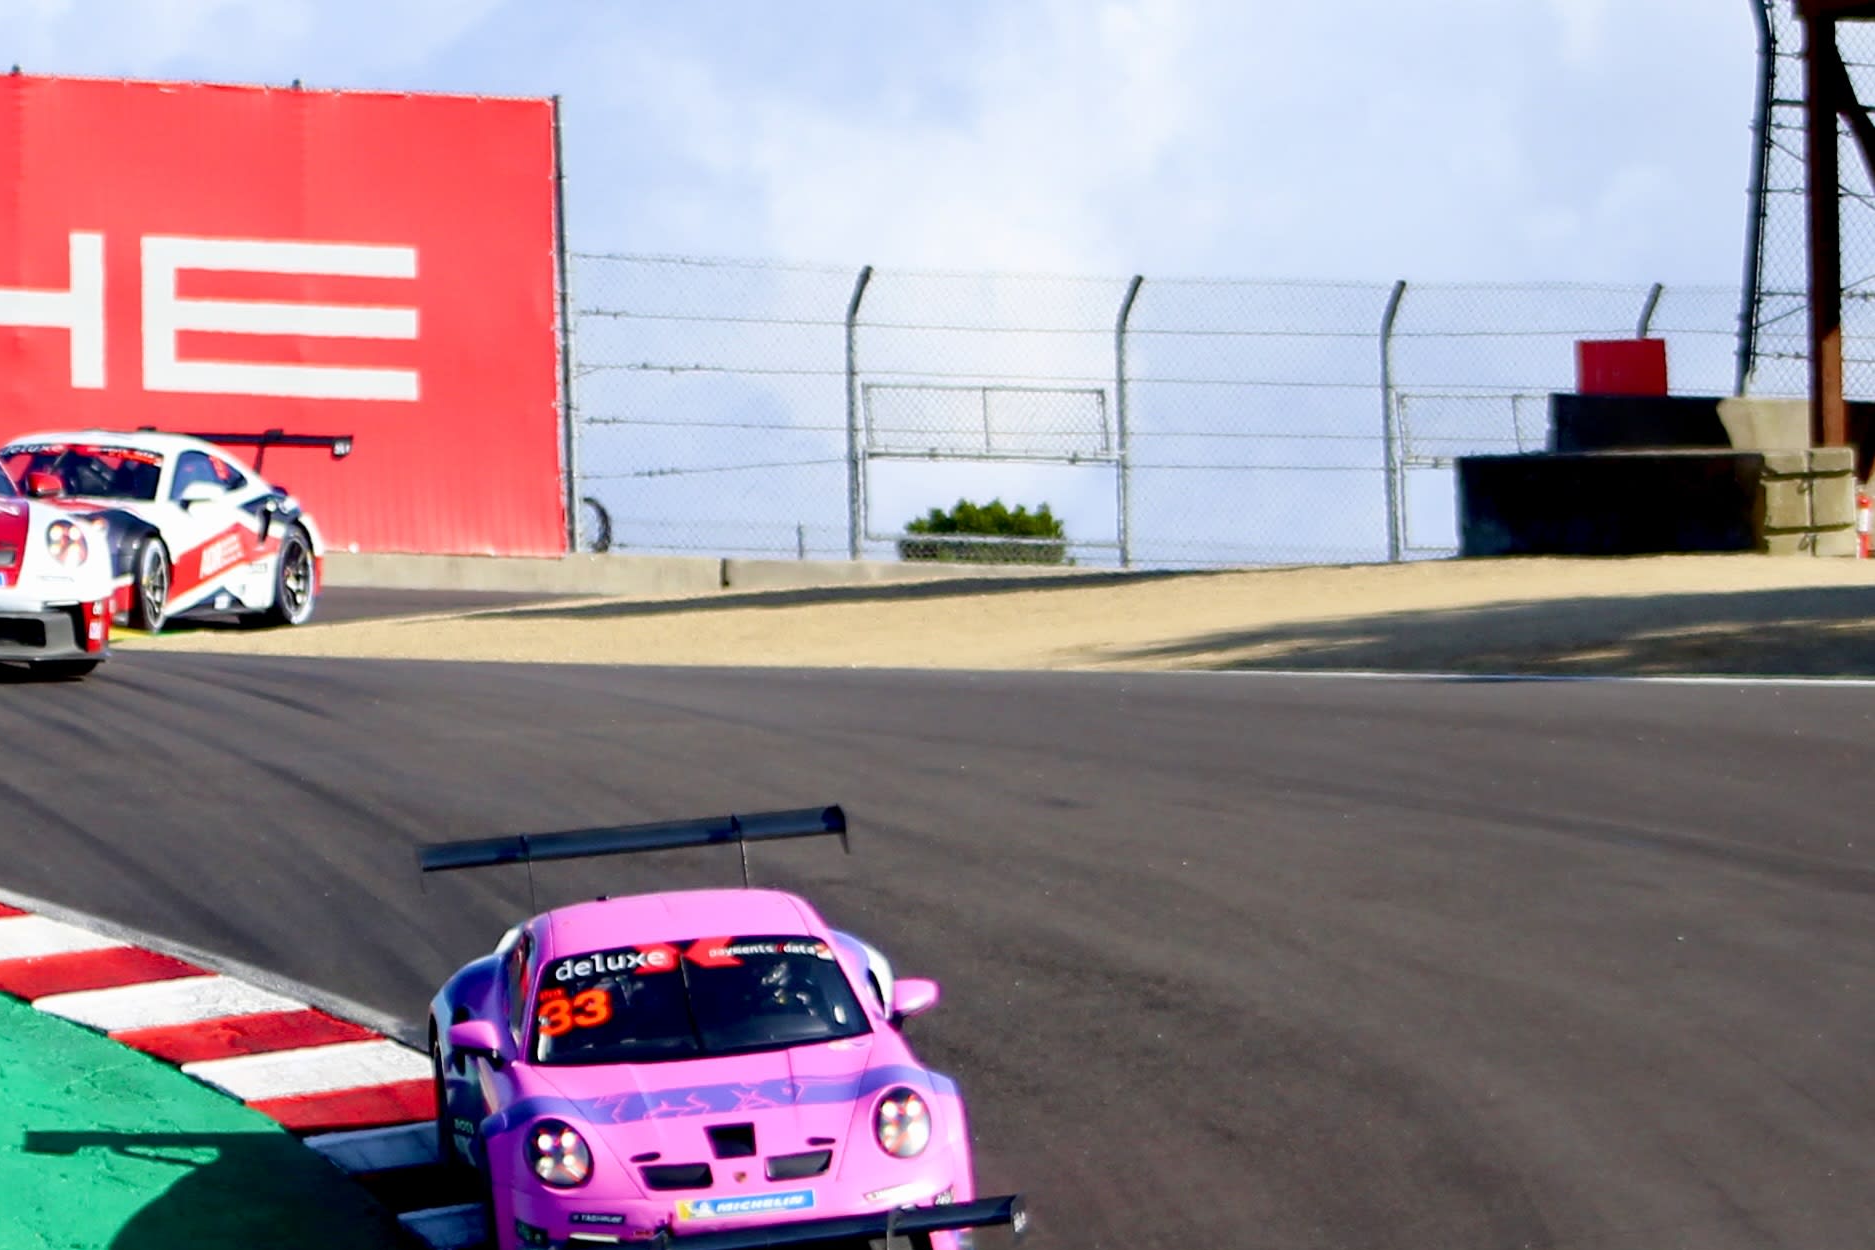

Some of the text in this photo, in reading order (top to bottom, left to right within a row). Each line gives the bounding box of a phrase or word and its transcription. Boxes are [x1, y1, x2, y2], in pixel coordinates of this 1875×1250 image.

[708, 942, 816, 958] payments data
[555, 951, 666, 981] deluxe
[539, 989, 611, 1037] 33
[716, 1194, 805, 1213] MICHELIN
